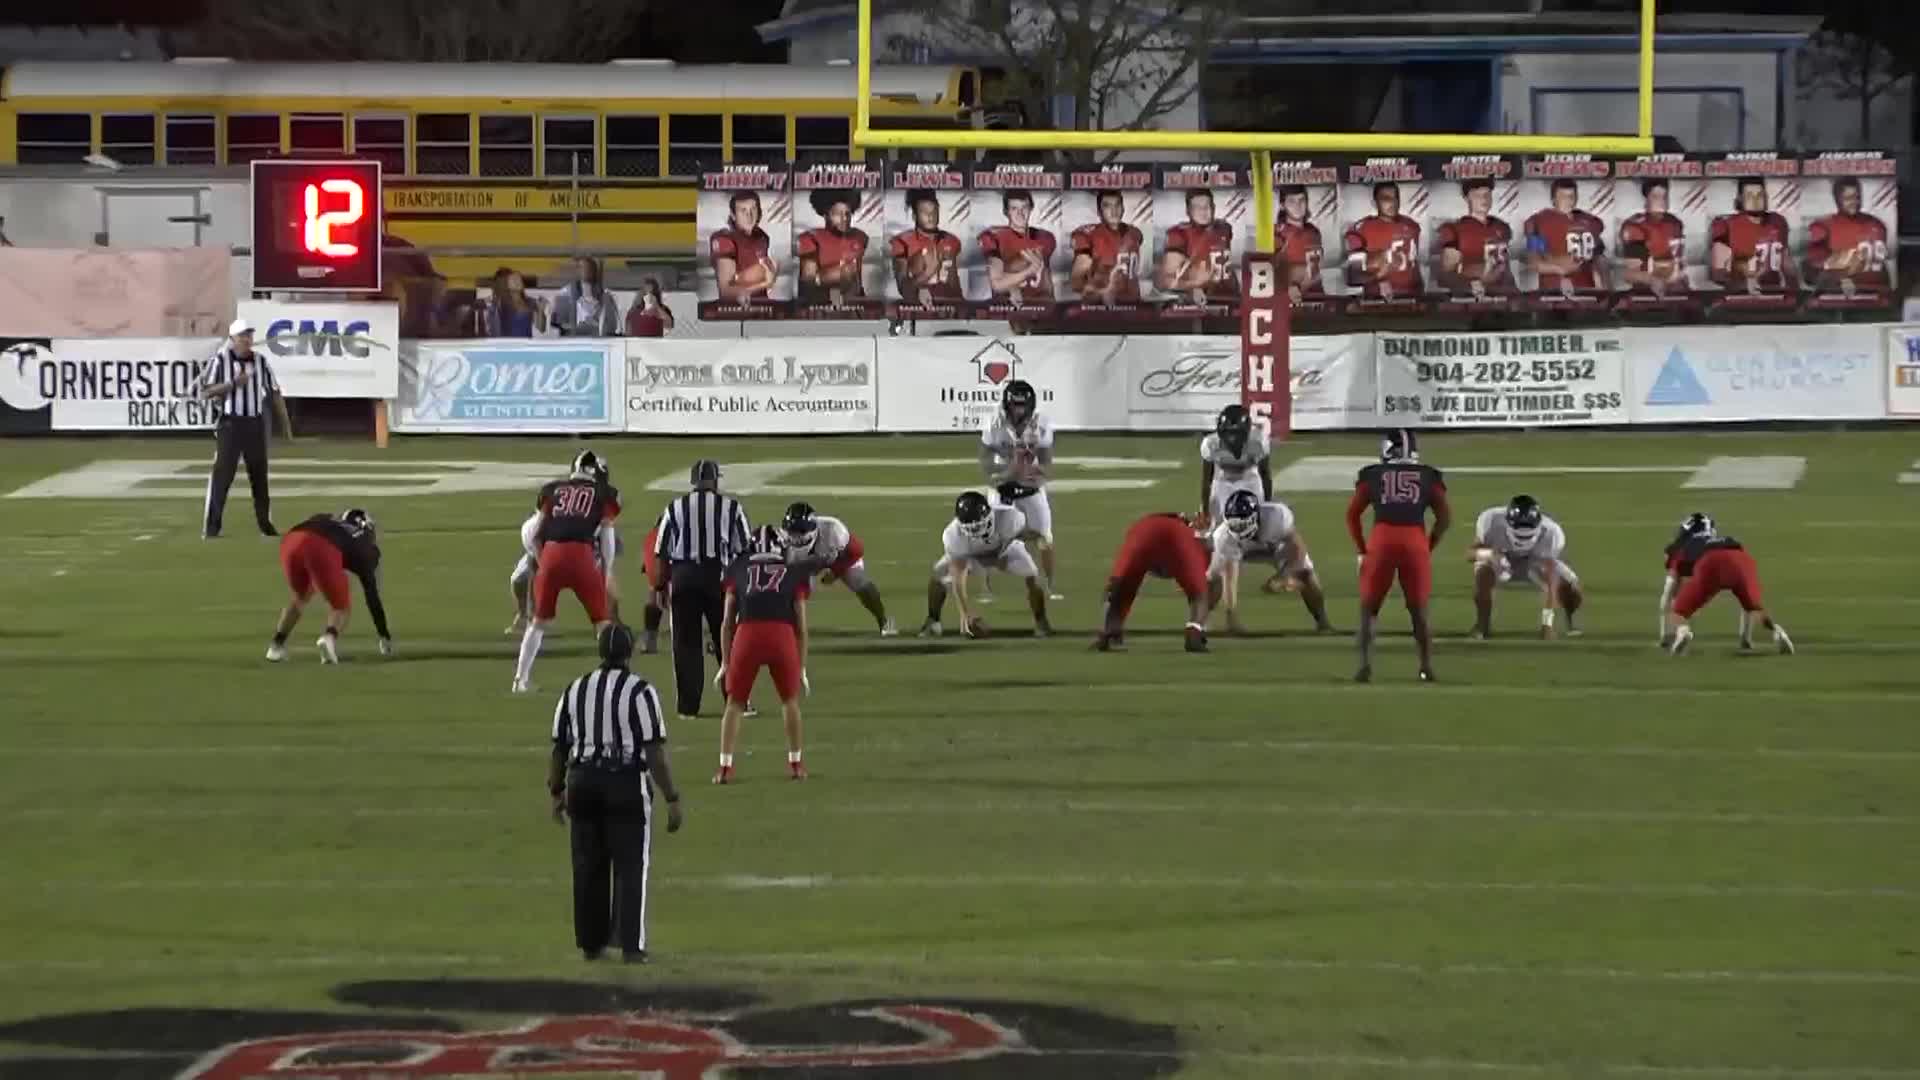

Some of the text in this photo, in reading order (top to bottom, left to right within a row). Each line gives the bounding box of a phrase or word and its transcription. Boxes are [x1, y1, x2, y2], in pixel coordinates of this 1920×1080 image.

[894, 172, 963, 188] LEWIS
[392, 191, 494, 208] TRANSPORTATION
[305, 179, 363, 257] 12
[264, 319, 371, 358] CMC
[1384, 338, 1490, 356] DIAMOND
[629, 356, 869, 394] Lyons and Lyons
[1416, 359, 1596, 383] 904-282-5552
[416, 352, 597, 418] Romeo
[128, 401, 179, 426] ROCK
[629, 396, 868, 413] Certified Public Accountants
[1431, 397, 1460, 412] WE
[1465, 397, 1500, 412] BUY
[1505, 395, 1575, 411] TIMBER
[1381, 471, 1421, 504] 15
[552, 487, 596, 518] 30
[746, 563, 787, 593] 17
